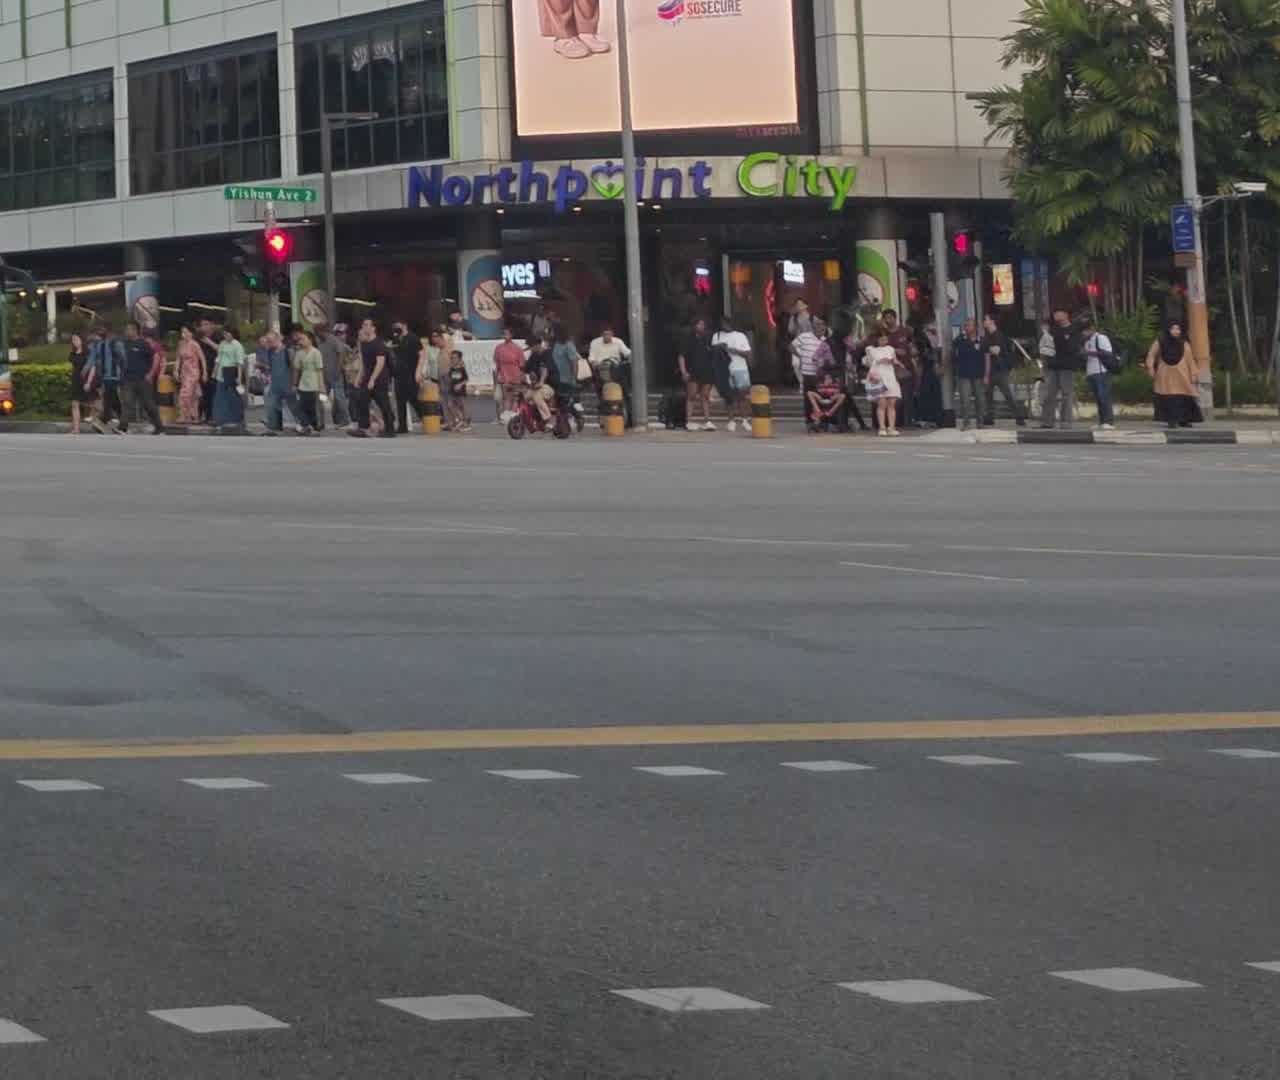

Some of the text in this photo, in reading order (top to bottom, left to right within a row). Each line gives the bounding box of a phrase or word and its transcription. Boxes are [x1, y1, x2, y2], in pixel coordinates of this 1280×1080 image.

[687, 0, 742, 16] SGSECURE
[737, 152, 856, 210] City
[230, 186, 312, 200] Yishun Ave 2
